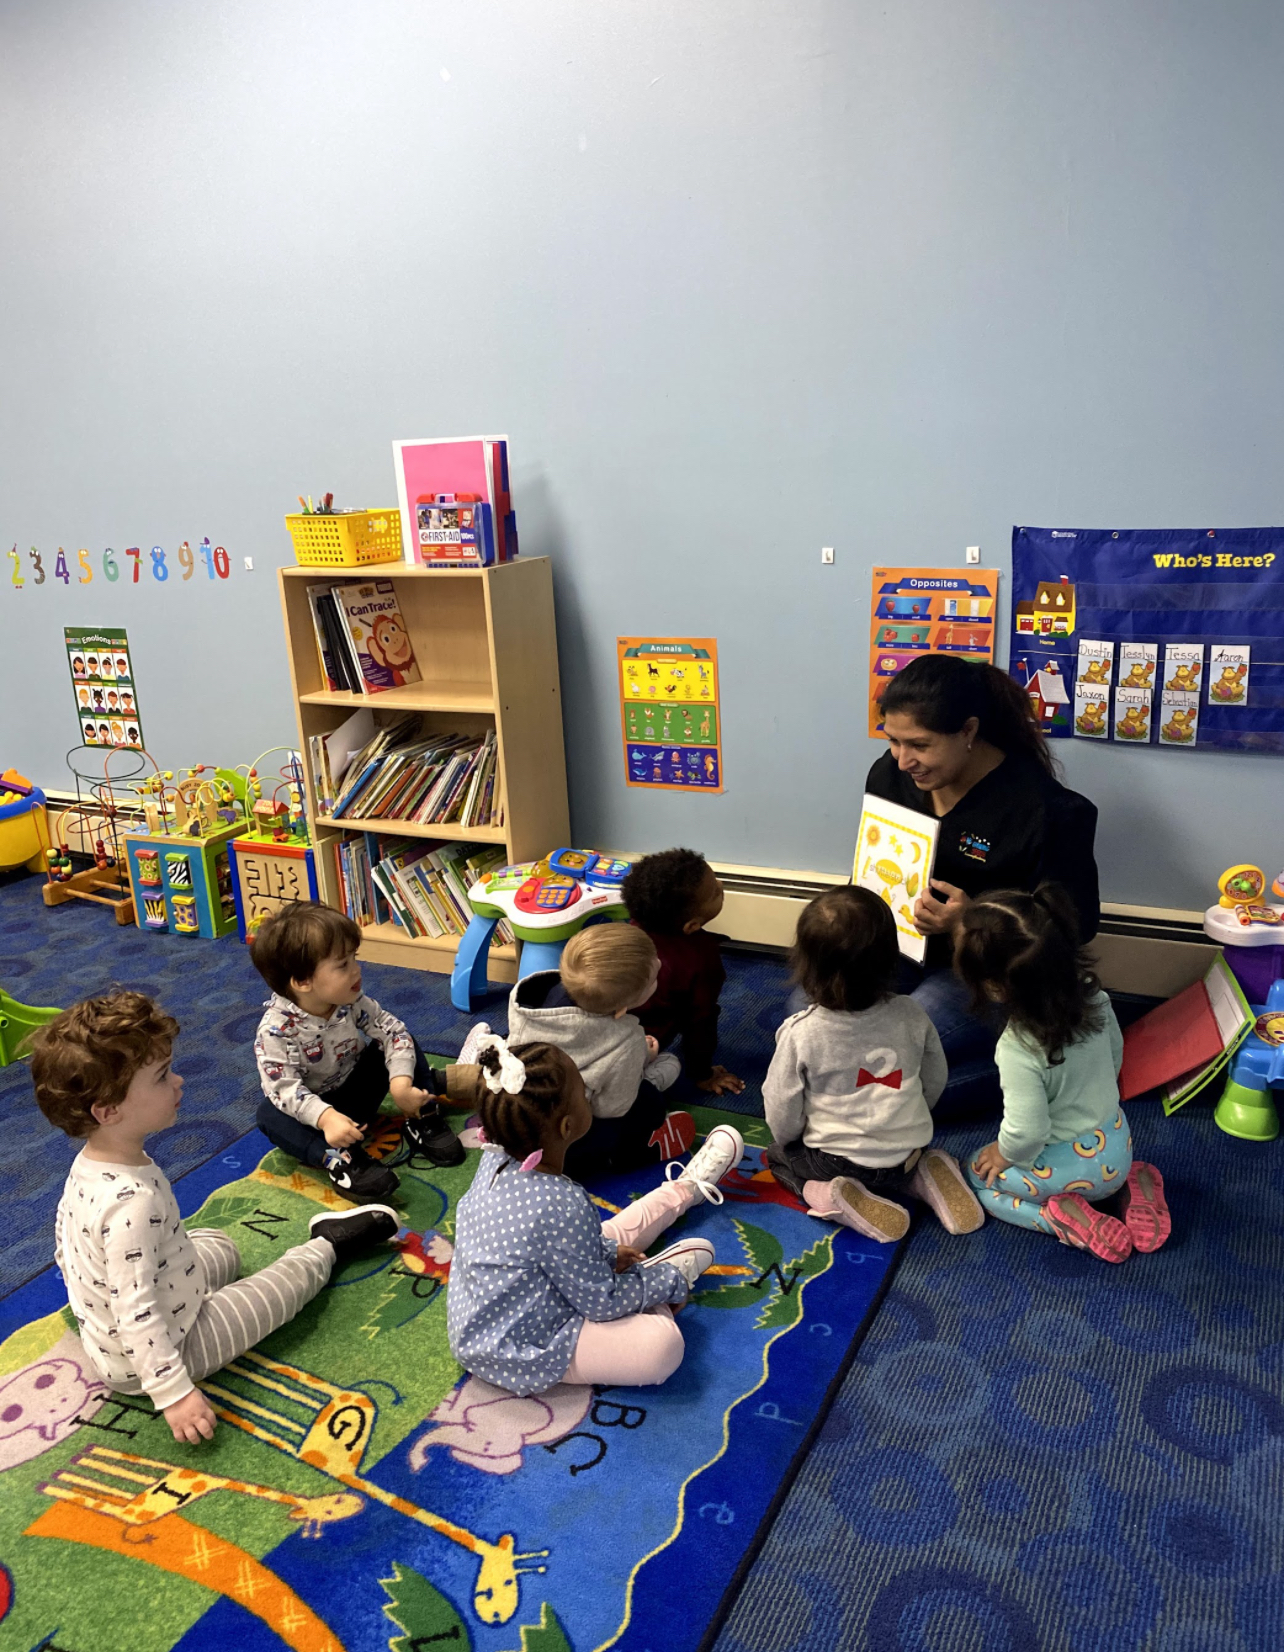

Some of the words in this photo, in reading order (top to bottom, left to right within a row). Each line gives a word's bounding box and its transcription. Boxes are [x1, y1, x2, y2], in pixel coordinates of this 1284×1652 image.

[7, 550, 25, 585] 2
[29, 550, 45, 584] 3
[55, 549, 70, 584] 4
[78, 549, 93, 584] 5
[103, 548, 119, 582] 6
[125, 548, 141, 583] 7
[151, 546, 168, 581] 8
[178, 543, 194, 581] 9
[200, 540, 230, 580] 10
[1153, 553, 1212, 568] Who's
[1215, 553, 1276, 568] Here?
[910, 579, 958, 588] Opposites
[351, 603, 369, 616] Can
[367, 599, 396, 612] Trace!
[81, 634, 111, 645] Emotions
[1079, 643, 1112, 659] Dustin
[1166, 647, 1200, 661] Tessa
[1214, 649, 1244, 662] Aaron
[1076, 684, 1106, 701] Jaxon
[1117, 688, 1150, 704] Sarah
[590, 1399, 647, 1429] B
[328, 1405, 366, 1451] G
